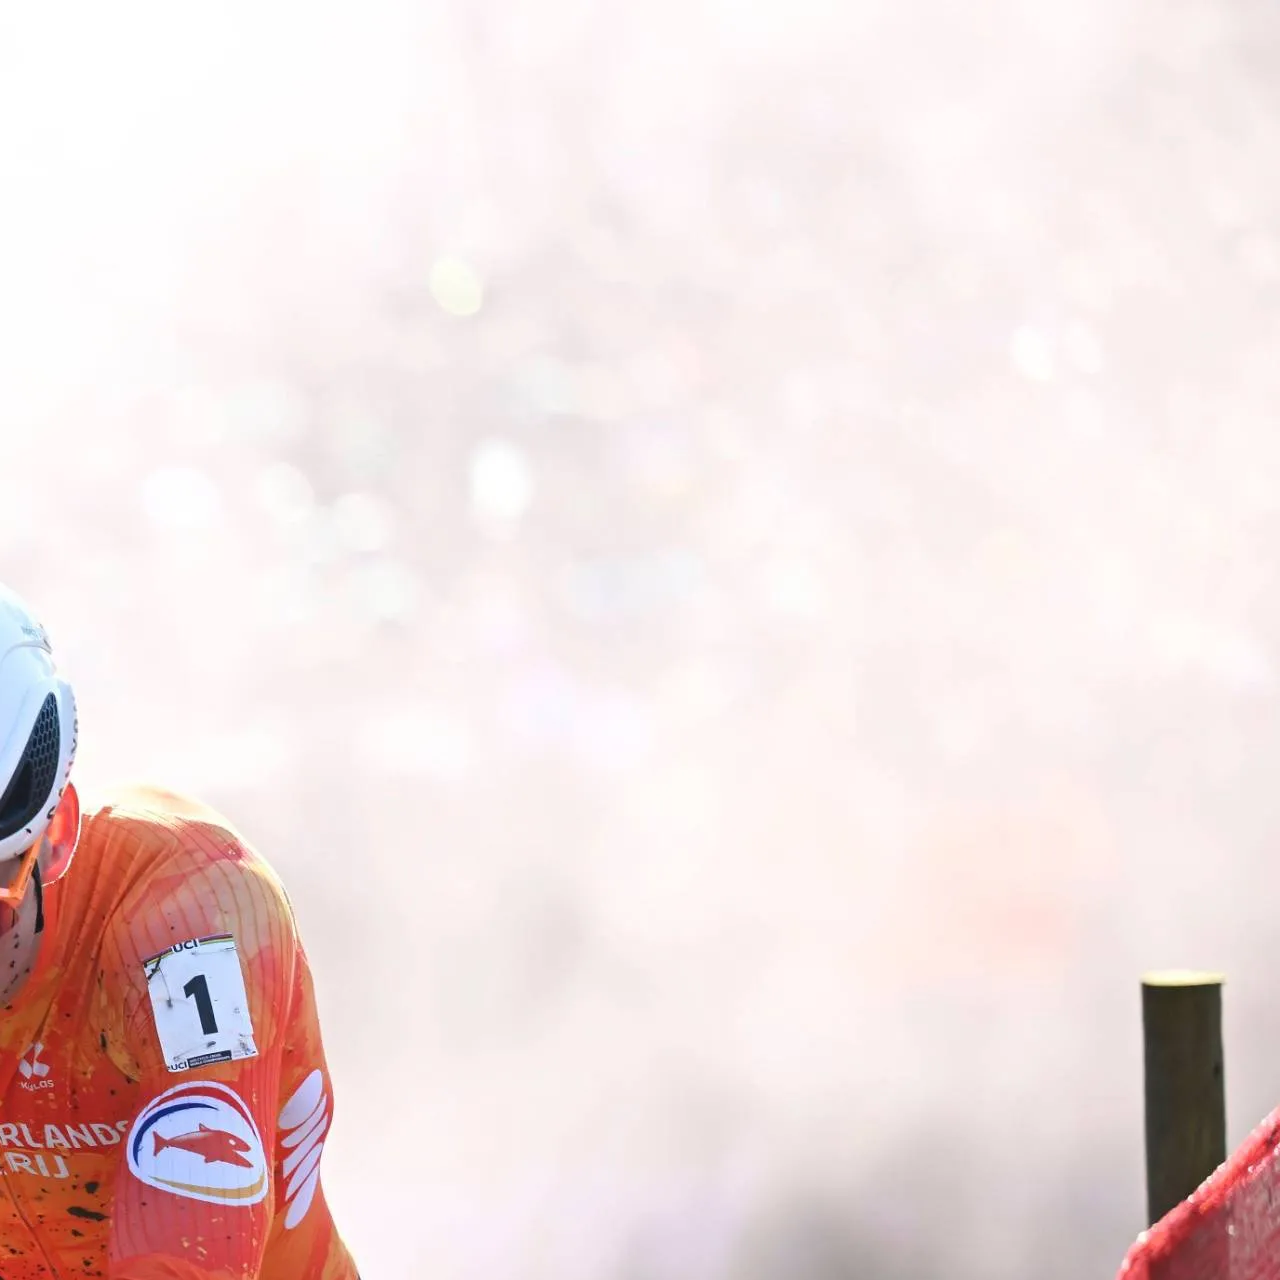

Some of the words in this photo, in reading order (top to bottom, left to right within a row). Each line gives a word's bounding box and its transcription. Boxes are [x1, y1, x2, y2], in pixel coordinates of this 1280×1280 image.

[172, 938, 199, 953] UCI
[183, 974, 219, 1035] 1
[170, 1061, 188, 1071] UCI
